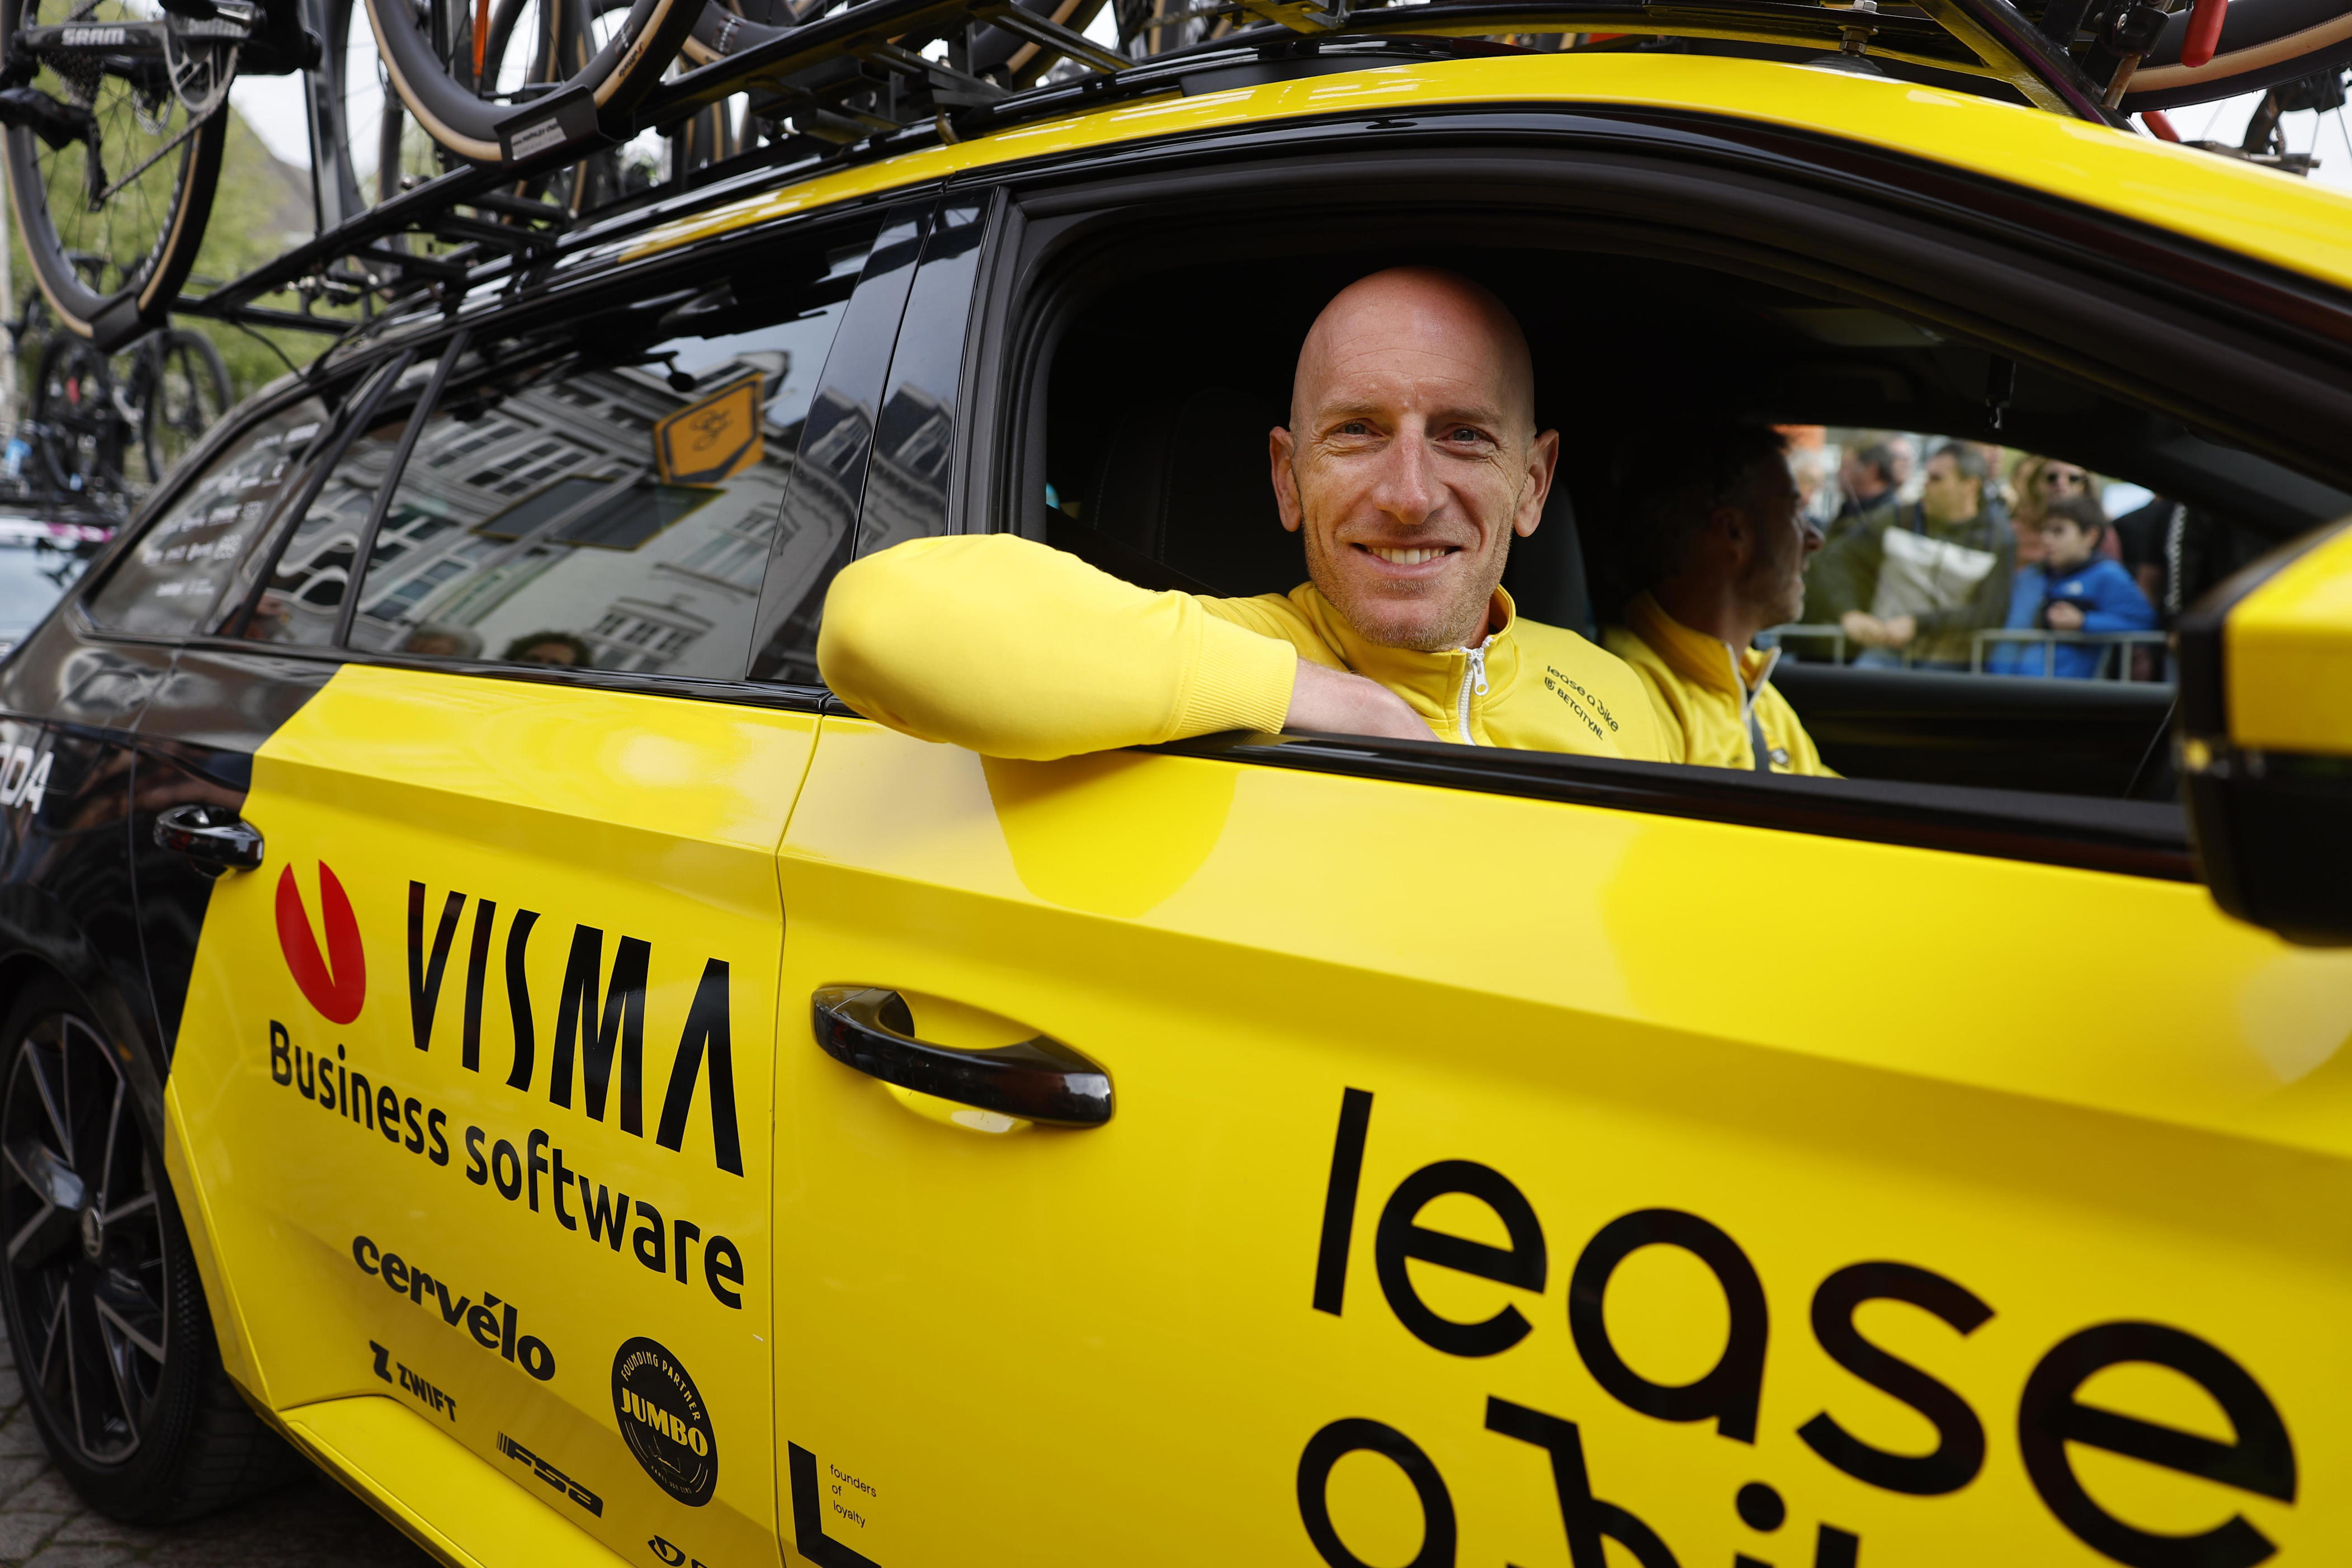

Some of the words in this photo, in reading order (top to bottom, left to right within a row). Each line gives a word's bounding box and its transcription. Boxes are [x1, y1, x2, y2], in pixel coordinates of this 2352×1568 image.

[1547, 665, 1586, 696] lease
[1587, 695, 1596, 707] a
[1557, 687, 1603, 741] BETCITY.NL
[408, 880, 744, 1178] VISMA
[270, 1019, 450, 1167] Business
[465, 1125, 744, 1310] software
[352, 1235, 556, 1381] cervélo
[1311, 1086, 2299, 1568] lease
[396, 1361, 457, 1423] ZWIFT
[620, 1350, 659, 1382] FOUNDING
[662, 1359, 701, 1421] PARTNER
[621, 1387, 709, 1457] JUMBO
[829, 1463, 877, 1499] founders
[831, 1483, 843, 1497] of
[833, 1499, 866, 1529] loyalty
